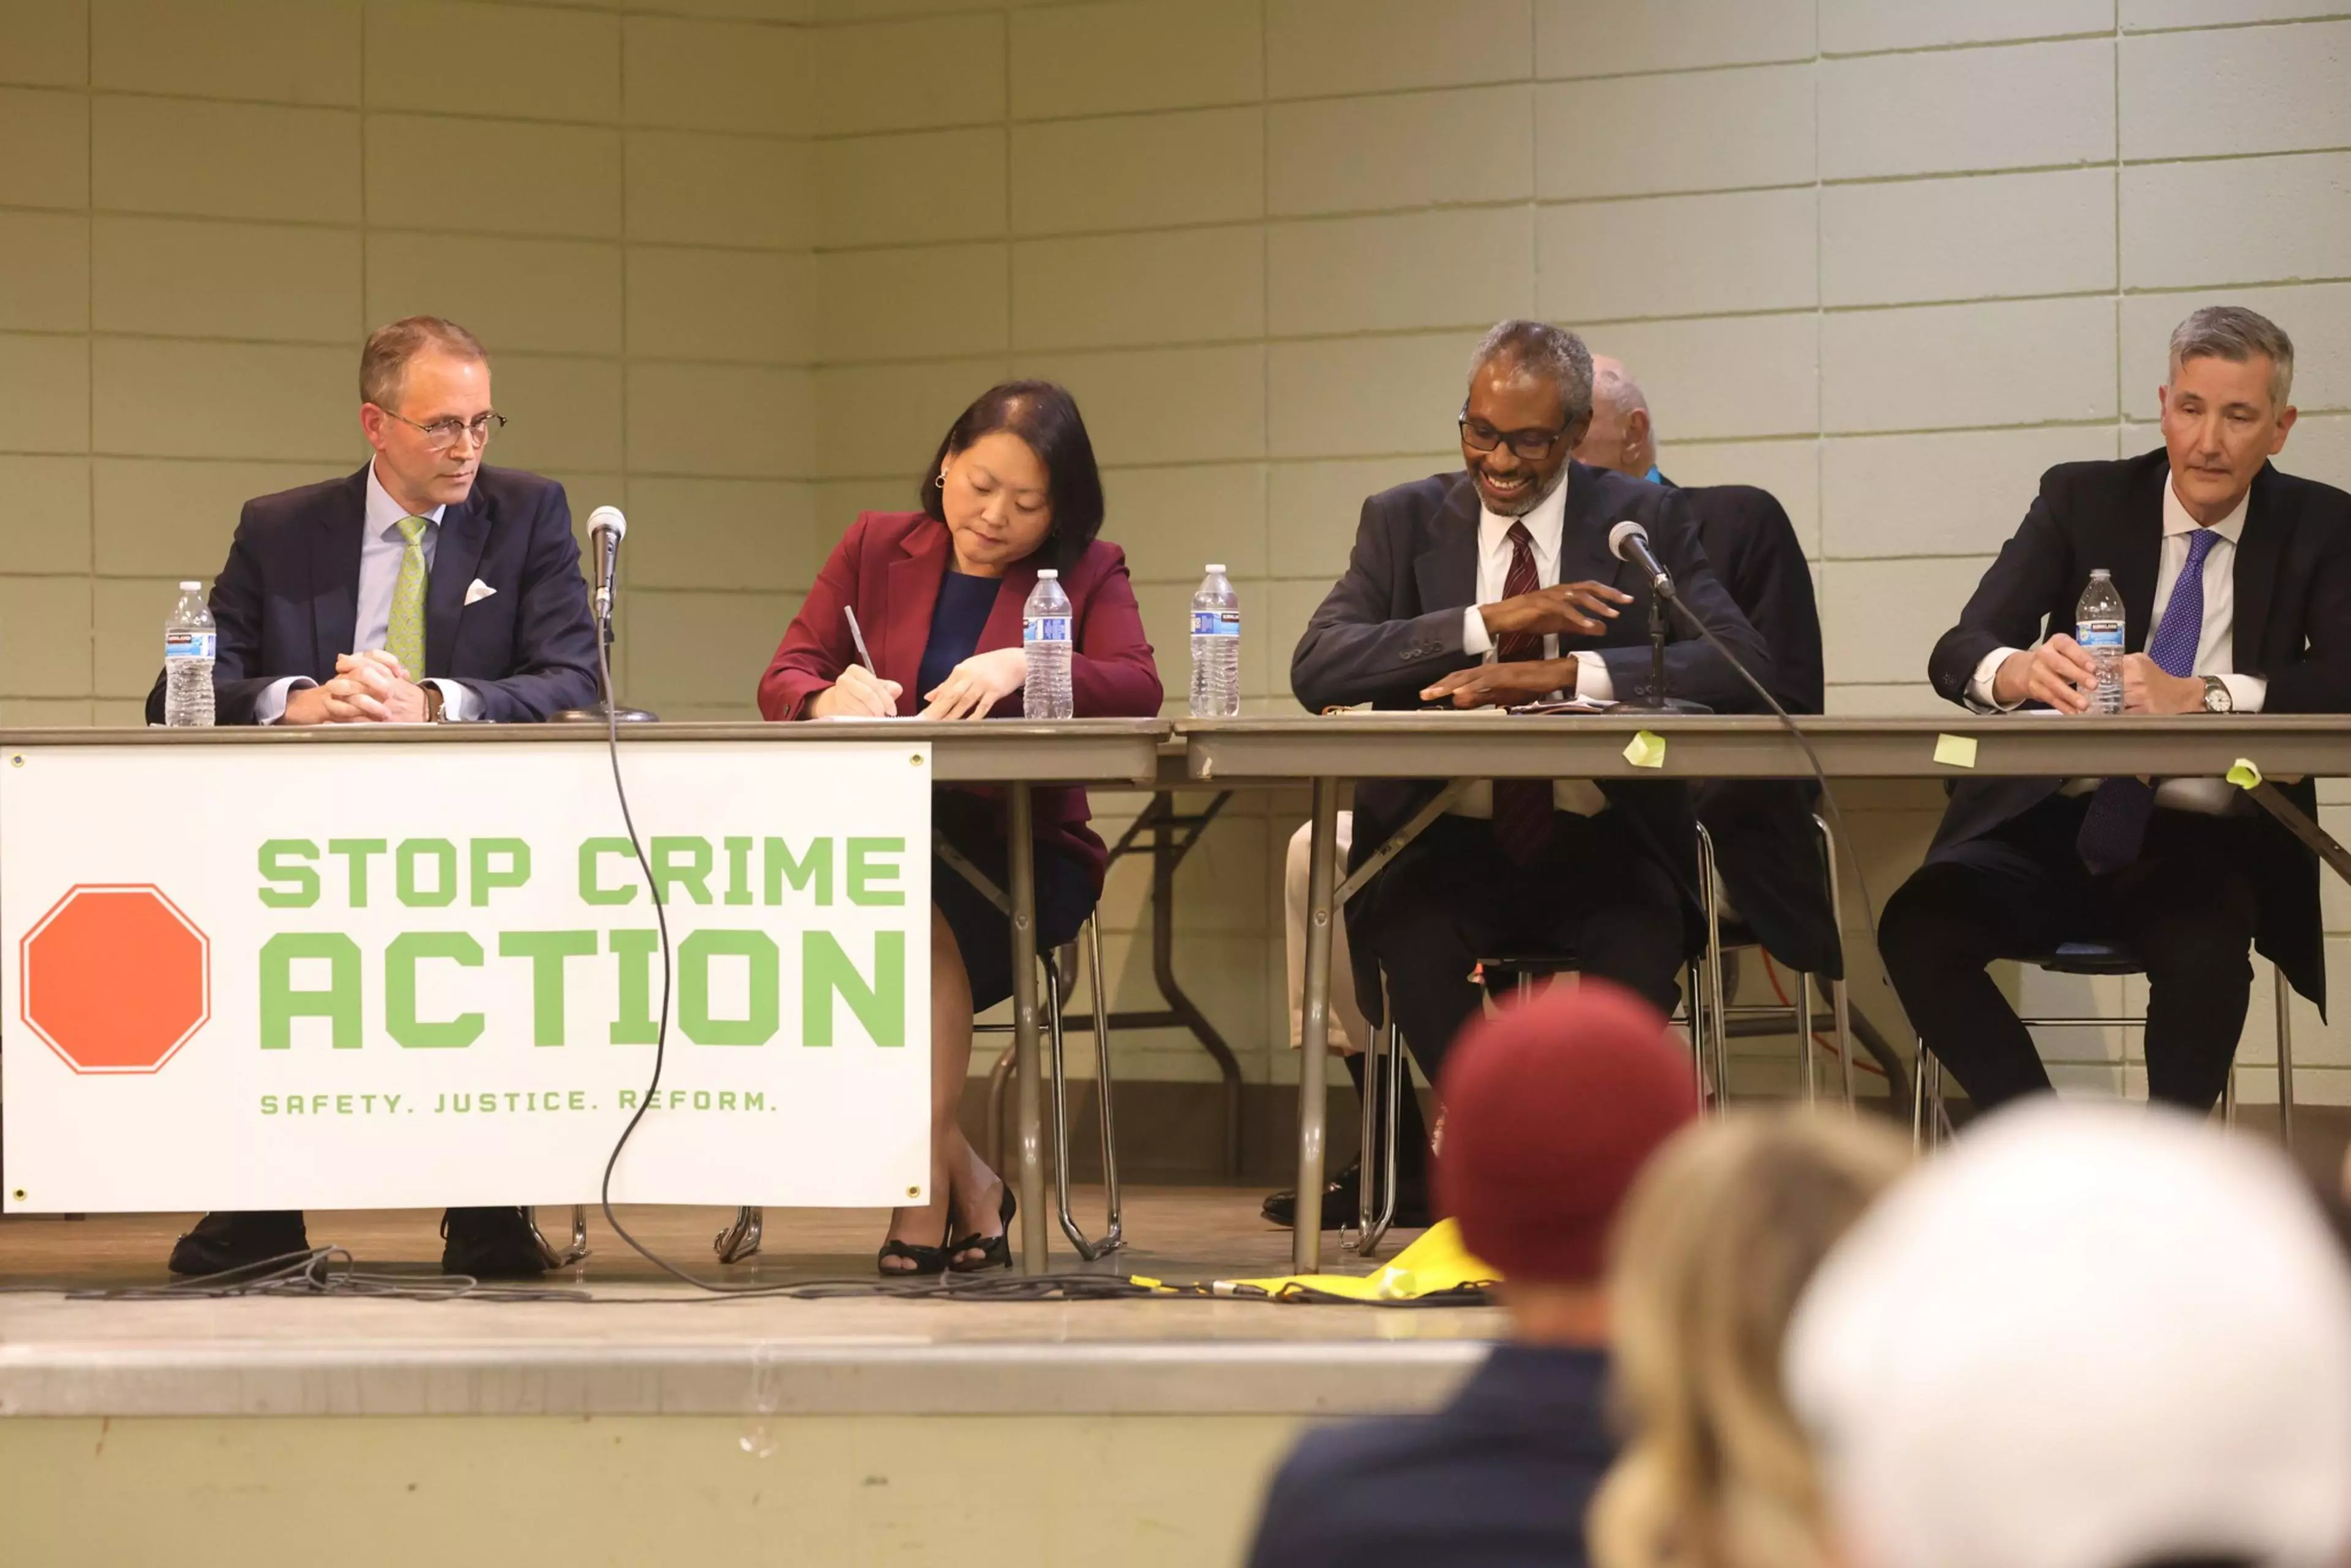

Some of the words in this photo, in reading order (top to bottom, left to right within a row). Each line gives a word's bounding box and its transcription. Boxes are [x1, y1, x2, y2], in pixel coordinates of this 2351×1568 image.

[258, 838, 531, 907] STOP
[579, 836, 906, 906] CRIME
[260, 929, 906, 1049] ACTION
[260, 1095, 414, 1114] SAFETY.
[434, 1090, 599, 1113] JUSTICE.
[618, 1089, 778, 1111] REFORM.
